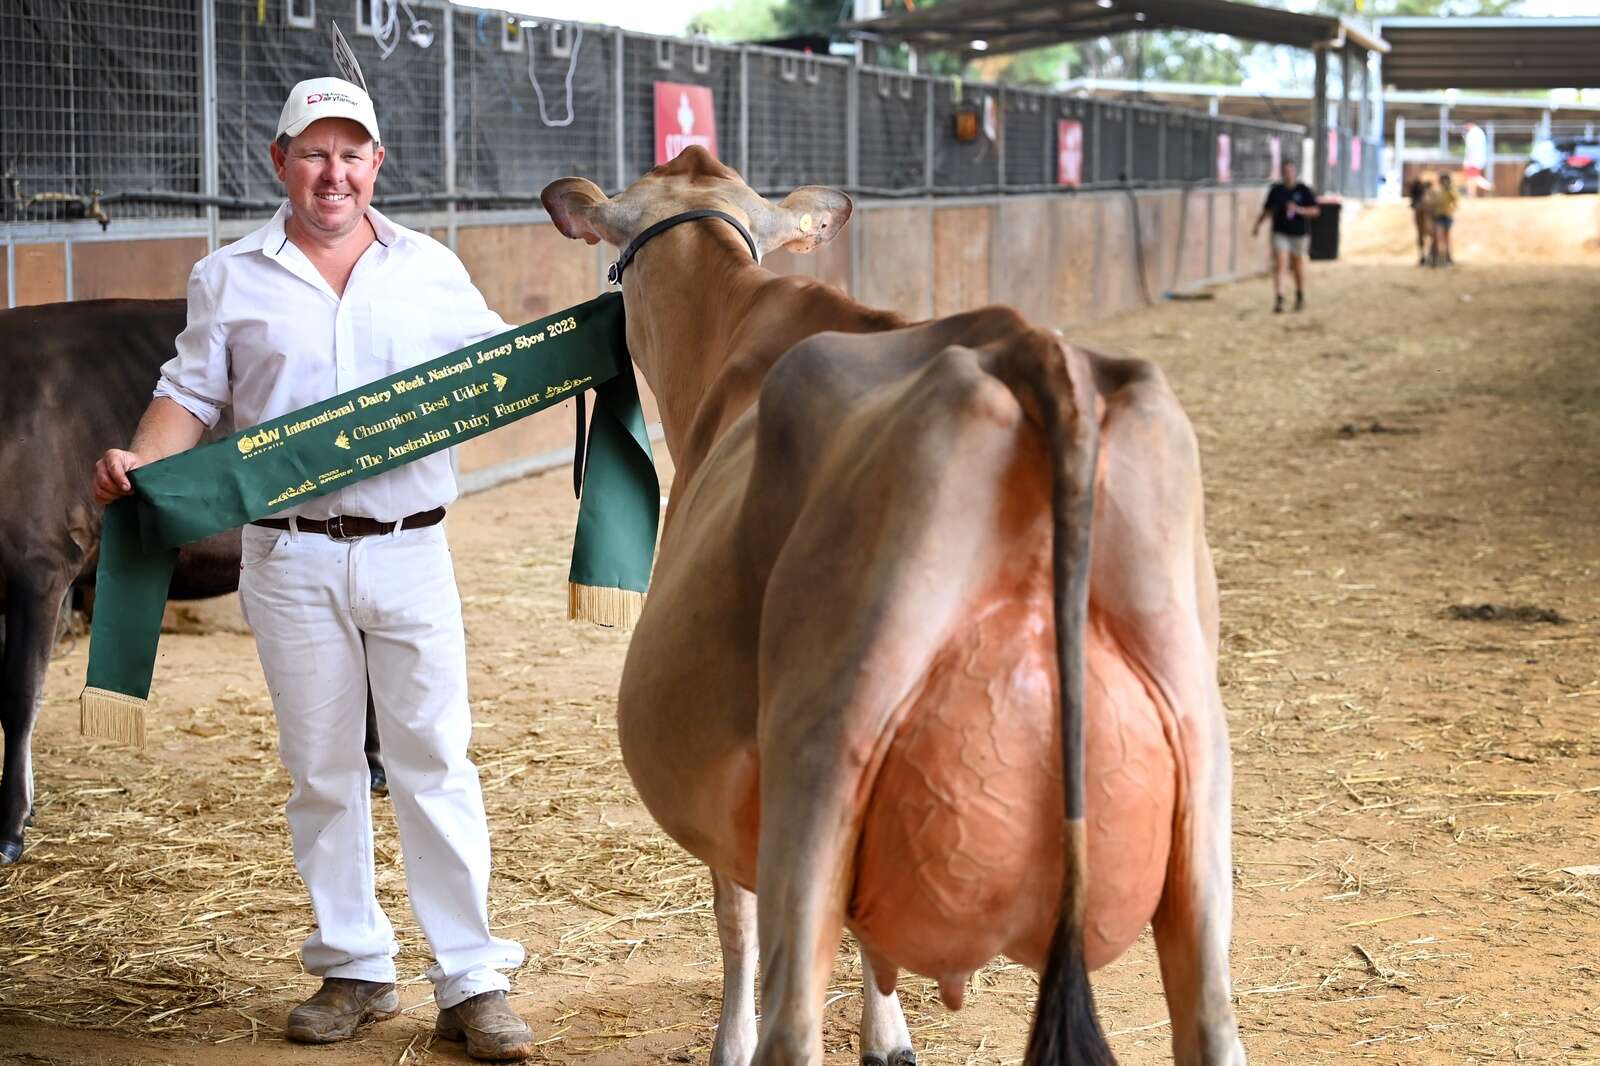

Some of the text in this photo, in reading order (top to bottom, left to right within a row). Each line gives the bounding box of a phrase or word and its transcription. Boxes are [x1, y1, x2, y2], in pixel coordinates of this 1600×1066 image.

[284, 317, 577, 437] International Dairy Week National Jersey Show 2023
[353, 381, 489, 440] Champion Best Udder
[356, 392, 540, 471] The Australian Dairy Farmer
